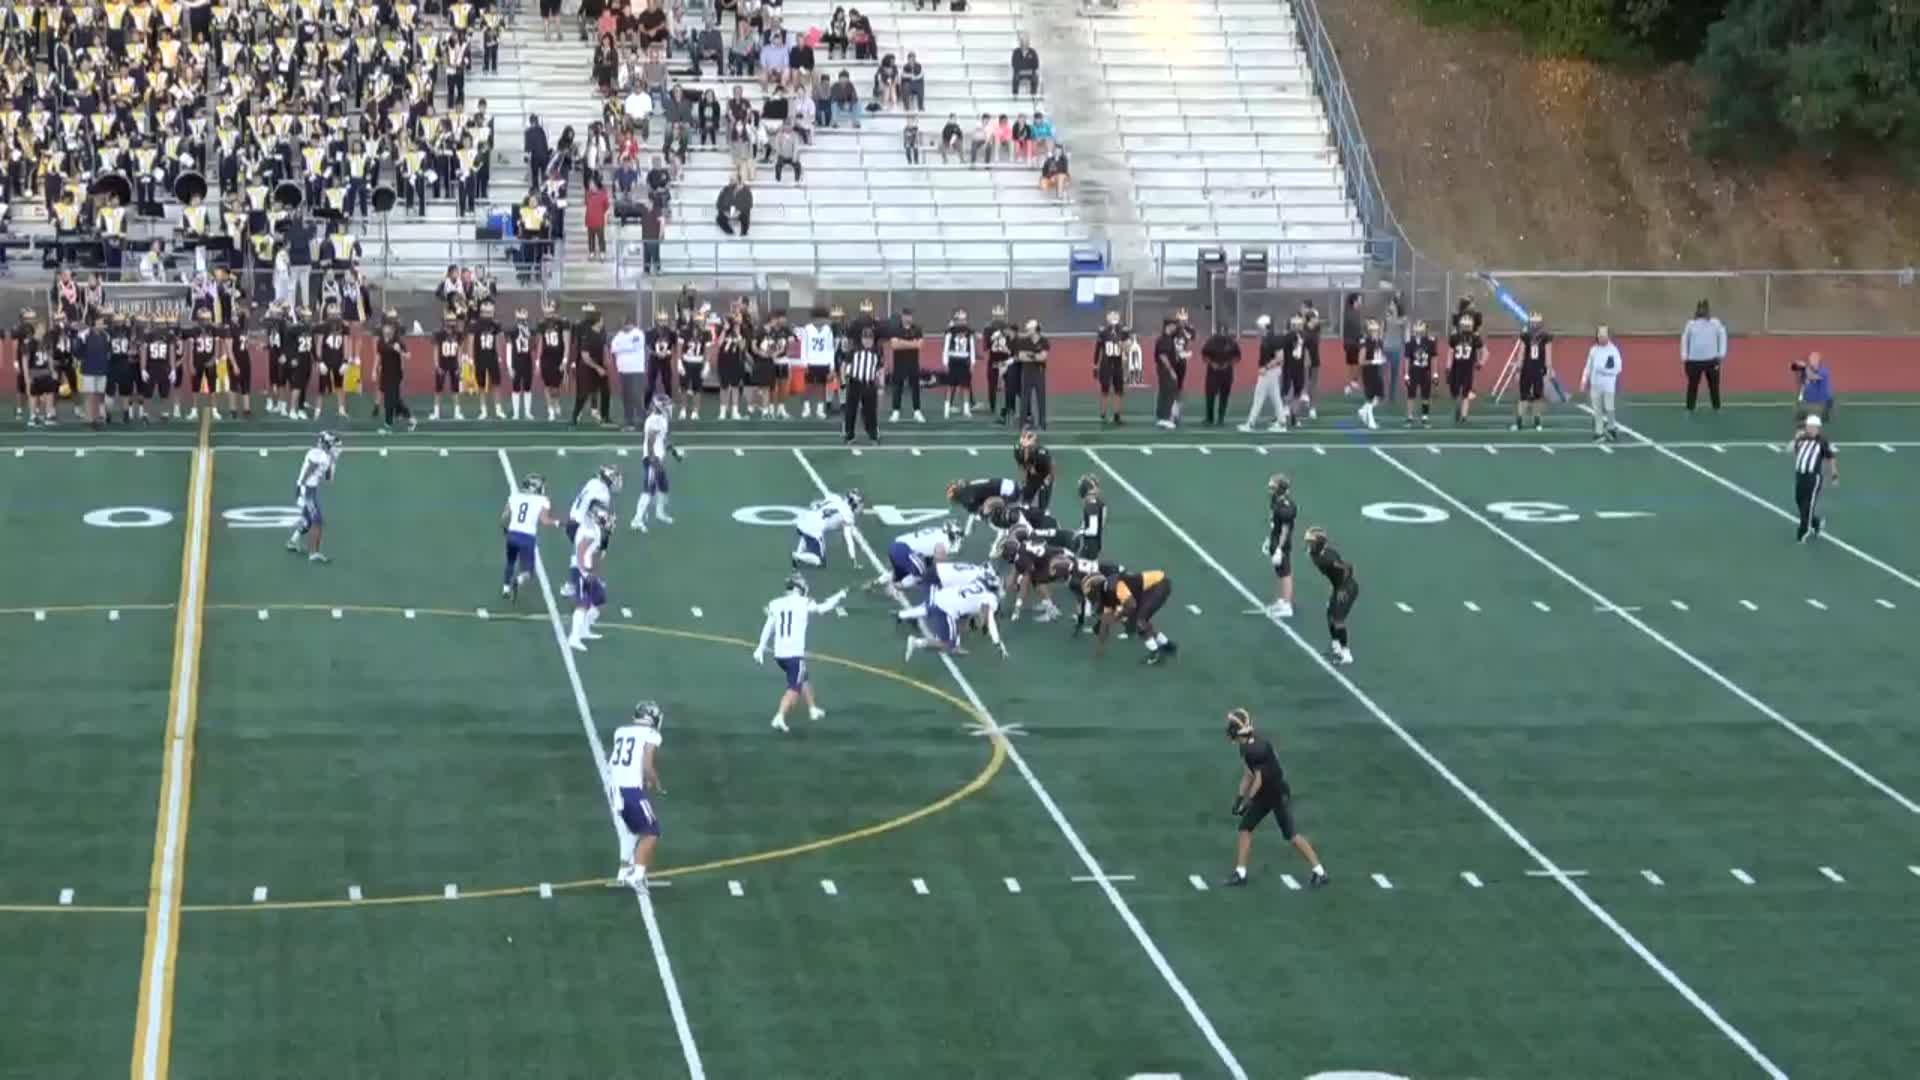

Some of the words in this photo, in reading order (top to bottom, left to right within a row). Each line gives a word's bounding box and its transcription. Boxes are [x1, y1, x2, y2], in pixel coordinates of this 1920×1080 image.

[518, 502, 529, 523] 8
[780, 610, 793, 638] 11
[612, 736, 636, 767] 33
